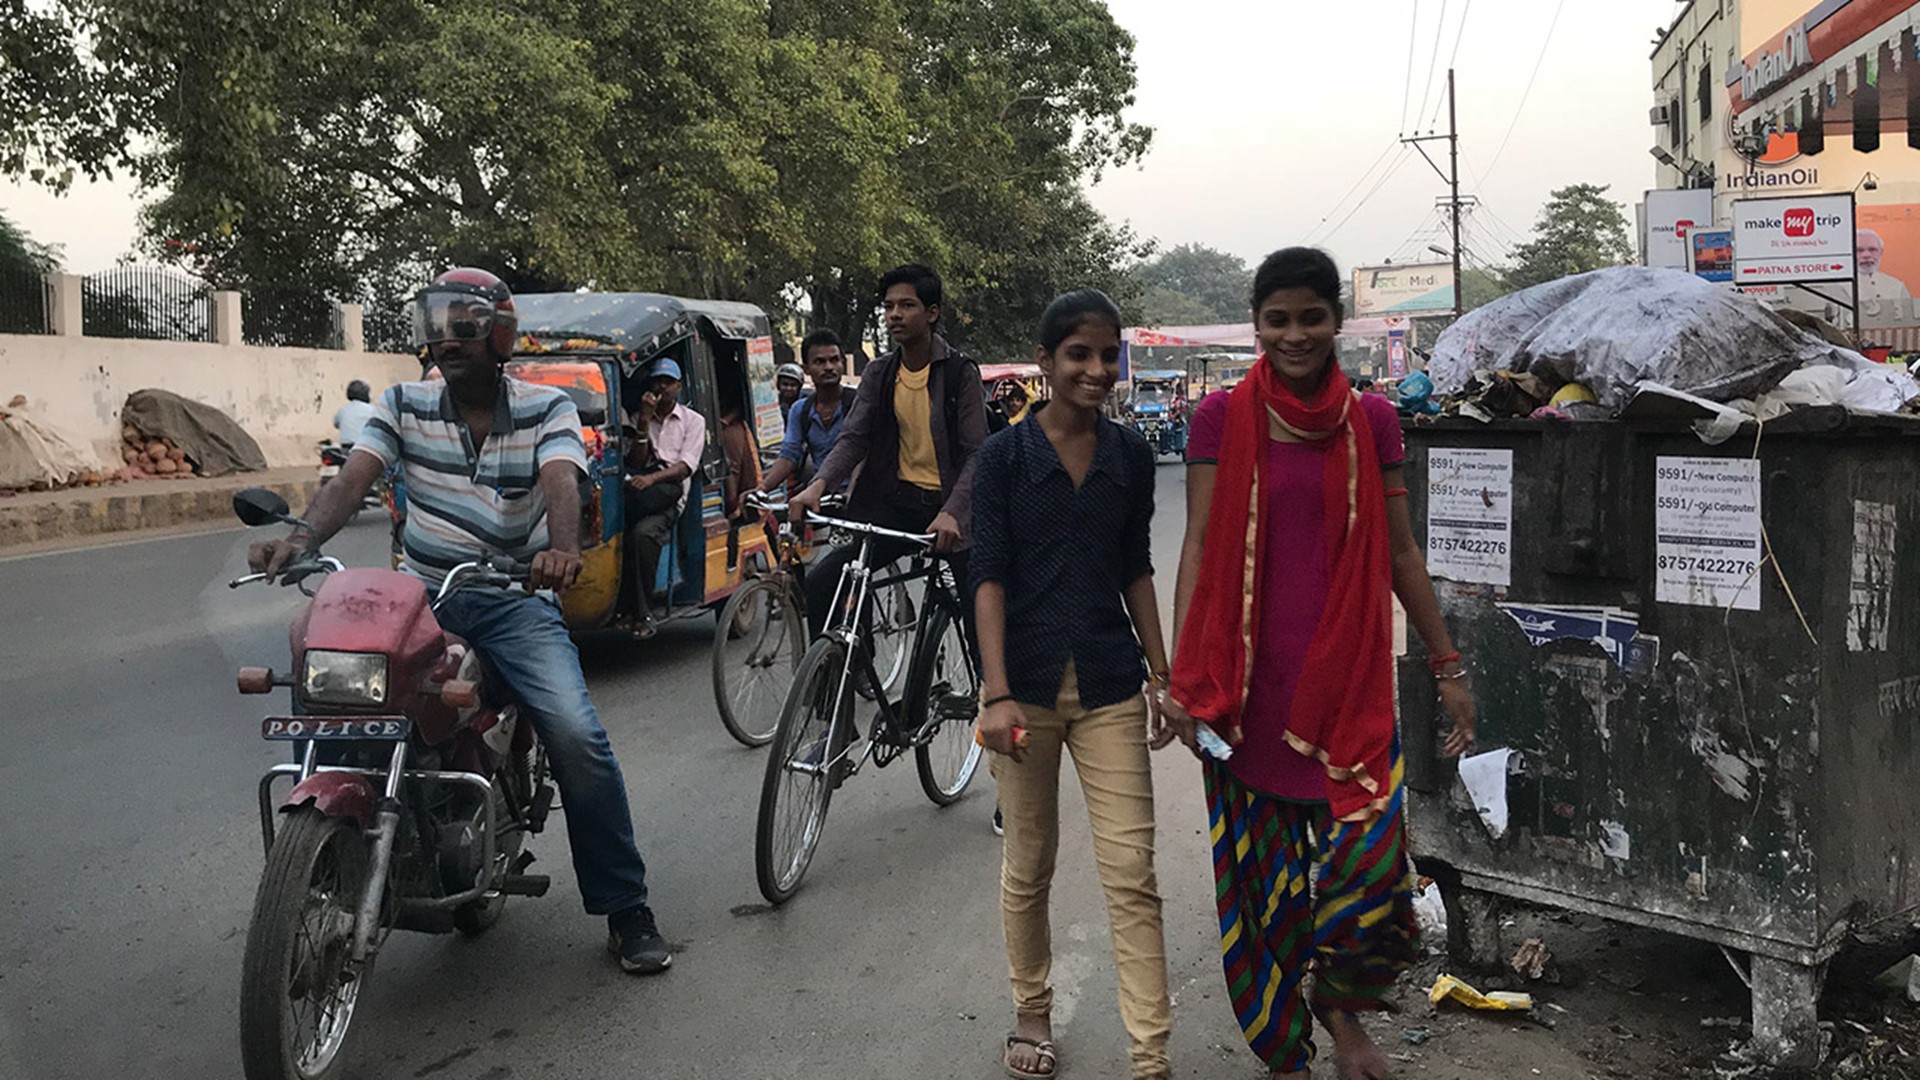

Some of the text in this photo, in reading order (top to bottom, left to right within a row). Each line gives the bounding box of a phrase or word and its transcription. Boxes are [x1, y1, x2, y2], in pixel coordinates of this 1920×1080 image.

[1740, 19, 1809, 100] IndianOil
[1726, 168, 1818, 188] IndianOil
[1744, 213, 1841, 234] make my trip
[1757, 264, 1829, 274] PATNA STORE
[1475, 488, 1508, 497] Coputer
[1714, 502, 1756, 513] Computer
[1429, 537, 1507, 555] 8757422276
[1658, 555, 1755, 575] 8757422276
[267, 720, 401, 736] POLICE
